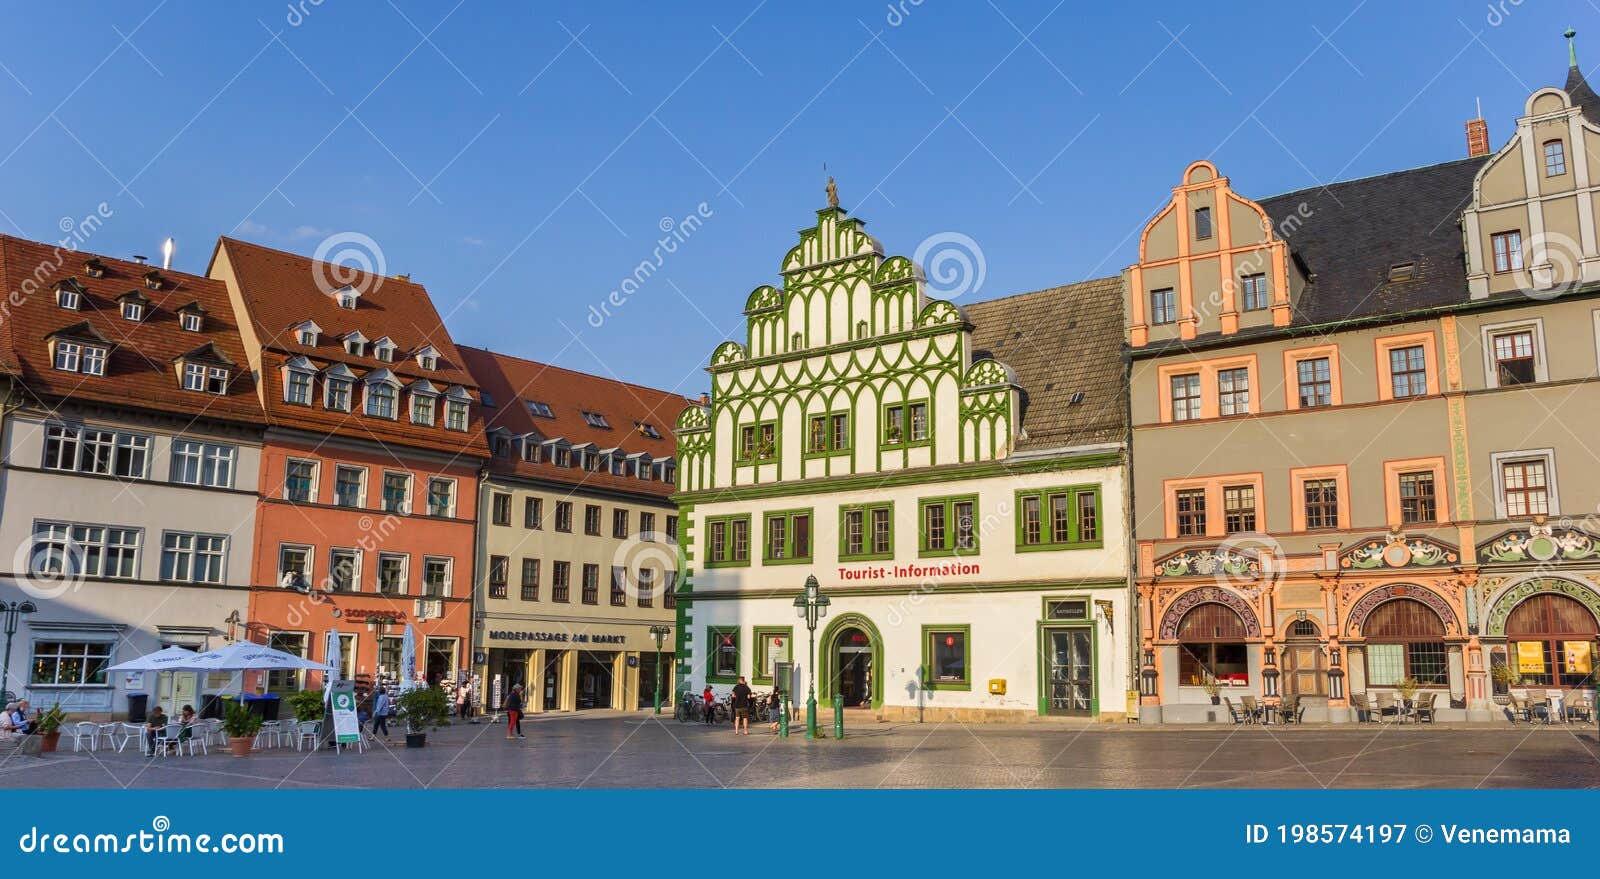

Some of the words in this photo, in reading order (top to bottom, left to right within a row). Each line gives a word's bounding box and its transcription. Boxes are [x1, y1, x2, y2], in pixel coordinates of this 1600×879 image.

[489, 630, 569, 642] MODEPASSAGE
[572, 633, 589, 643] AM
[592, 634, 626, 644] MARKT
